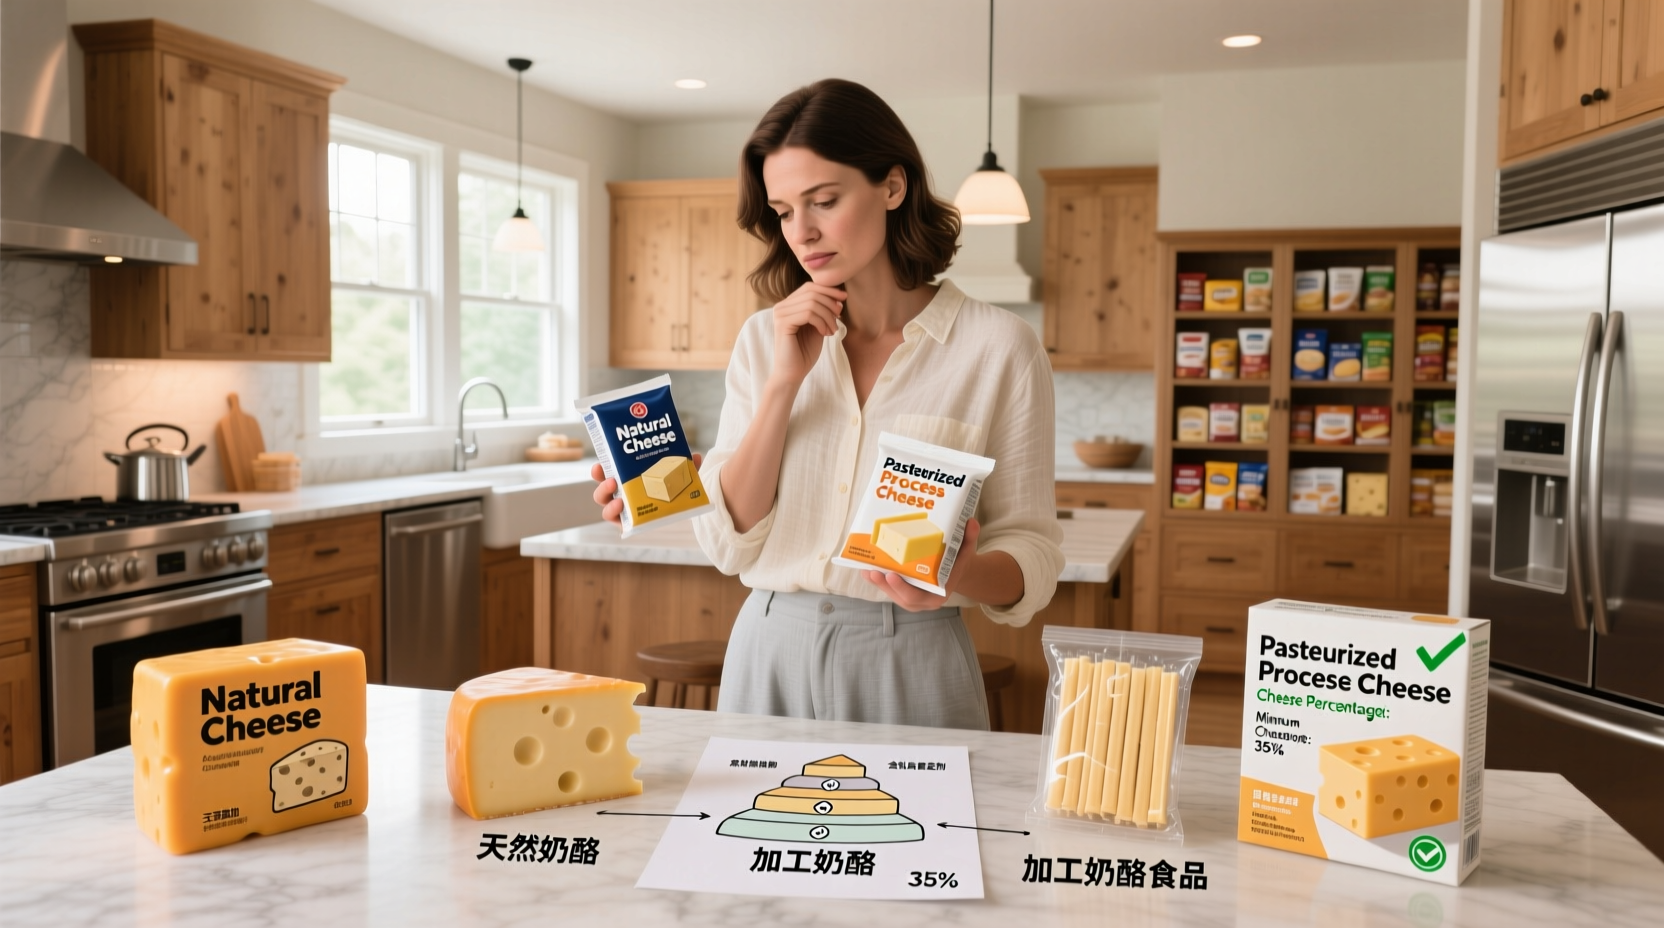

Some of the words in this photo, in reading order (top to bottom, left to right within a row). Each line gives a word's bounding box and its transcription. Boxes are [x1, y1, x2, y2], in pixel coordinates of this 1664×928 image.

[616, 413, 672, 441] Natural
[623, 431, 676, 454] Cheese
[876, 485, 935, 510] Cheese
[880, 470, 945, 497] Process
[1260, 635, 1396, 670] Pasteurized
[201, 670, 321, 715] Natural
[1259, 660, 1352, 691] Procese
[1357, 673, 1451, 704] Cheese
[201, 707, 321, 745] Cheese
[750, 847, 876, 876] 加工奶酪
[908, 871, 959, 888] 35%
